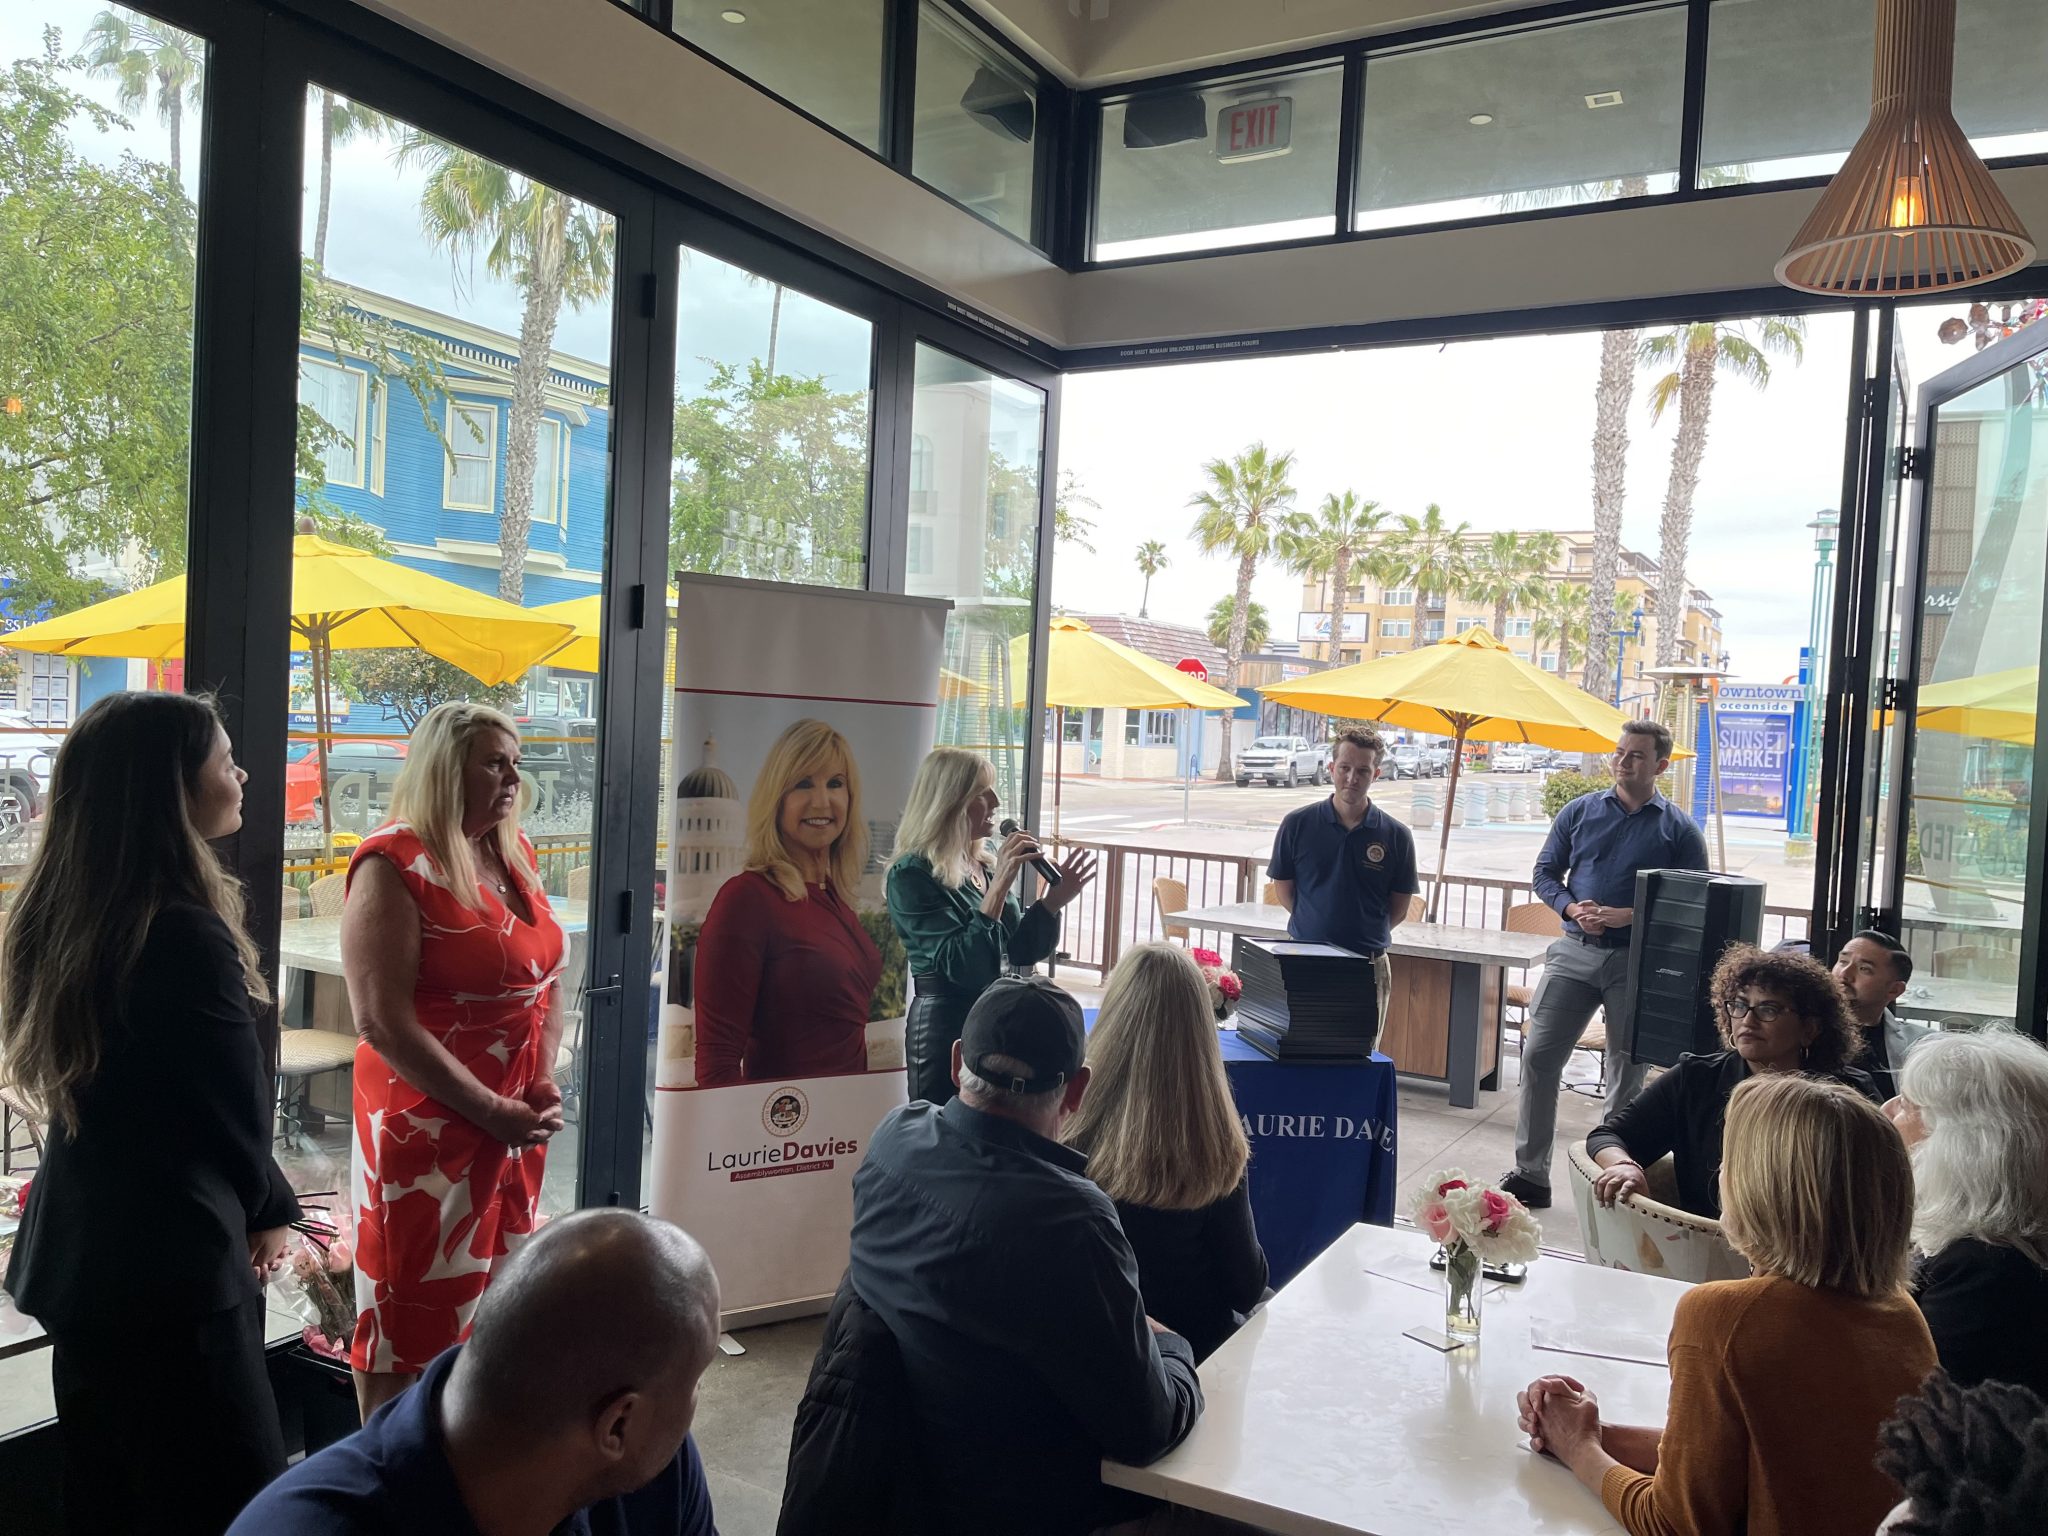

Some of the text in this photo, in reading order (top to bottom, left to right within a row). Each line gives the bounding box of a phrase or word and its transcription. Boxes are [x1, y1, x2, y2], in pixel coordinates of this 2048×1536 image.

[1231, 105, 1280, 151] EXIT
[1216, 341, 1241, 349] BUSINESS
[1720, 702, 1788, 711] oceanside
[1719, 730, 1785, 751] SUNSET
[1719, 748, 1784, 769] MARKET
[1241, 1113, 1325, 1138] AURIE
[796, 1162, 820, 1172] District
